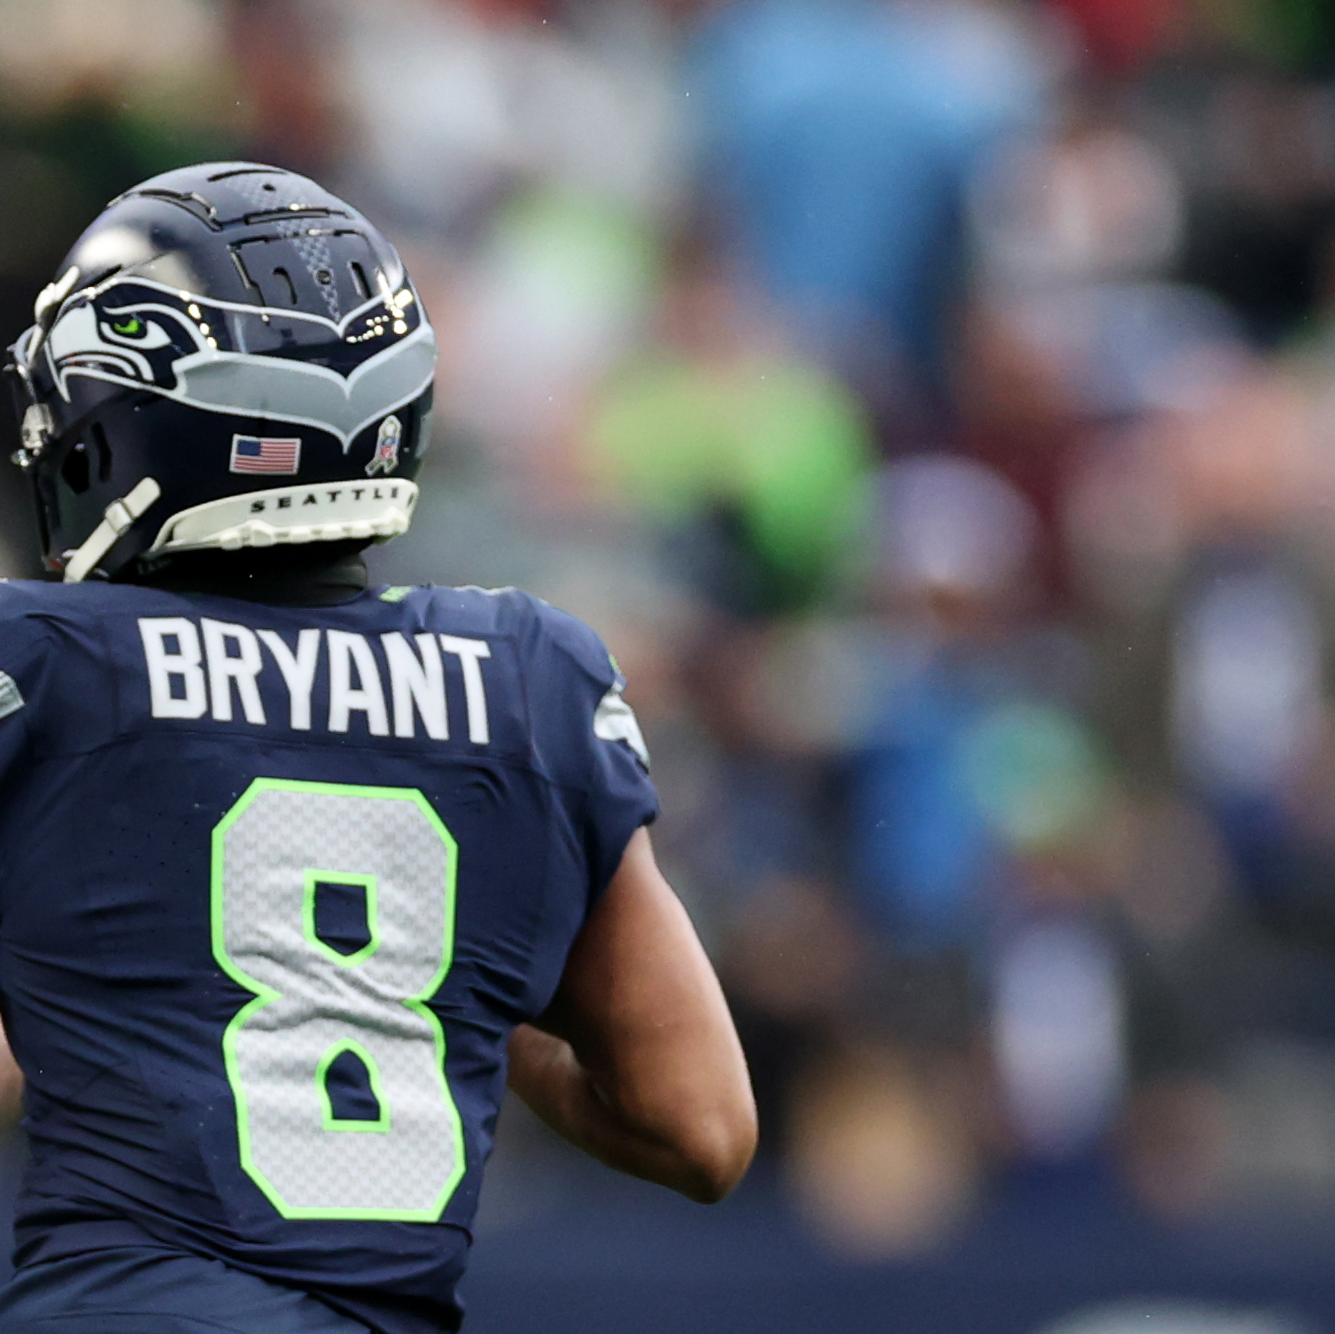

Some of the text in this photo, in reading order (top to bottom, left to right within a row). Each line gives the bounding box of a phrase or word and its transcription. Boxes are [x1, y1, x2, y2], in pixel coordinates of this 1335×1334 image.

[250, 487, 399, 514] SEATTLE
[137, 616, 492, 746] BRYANT
[211, 776, 467, 1223] 8
